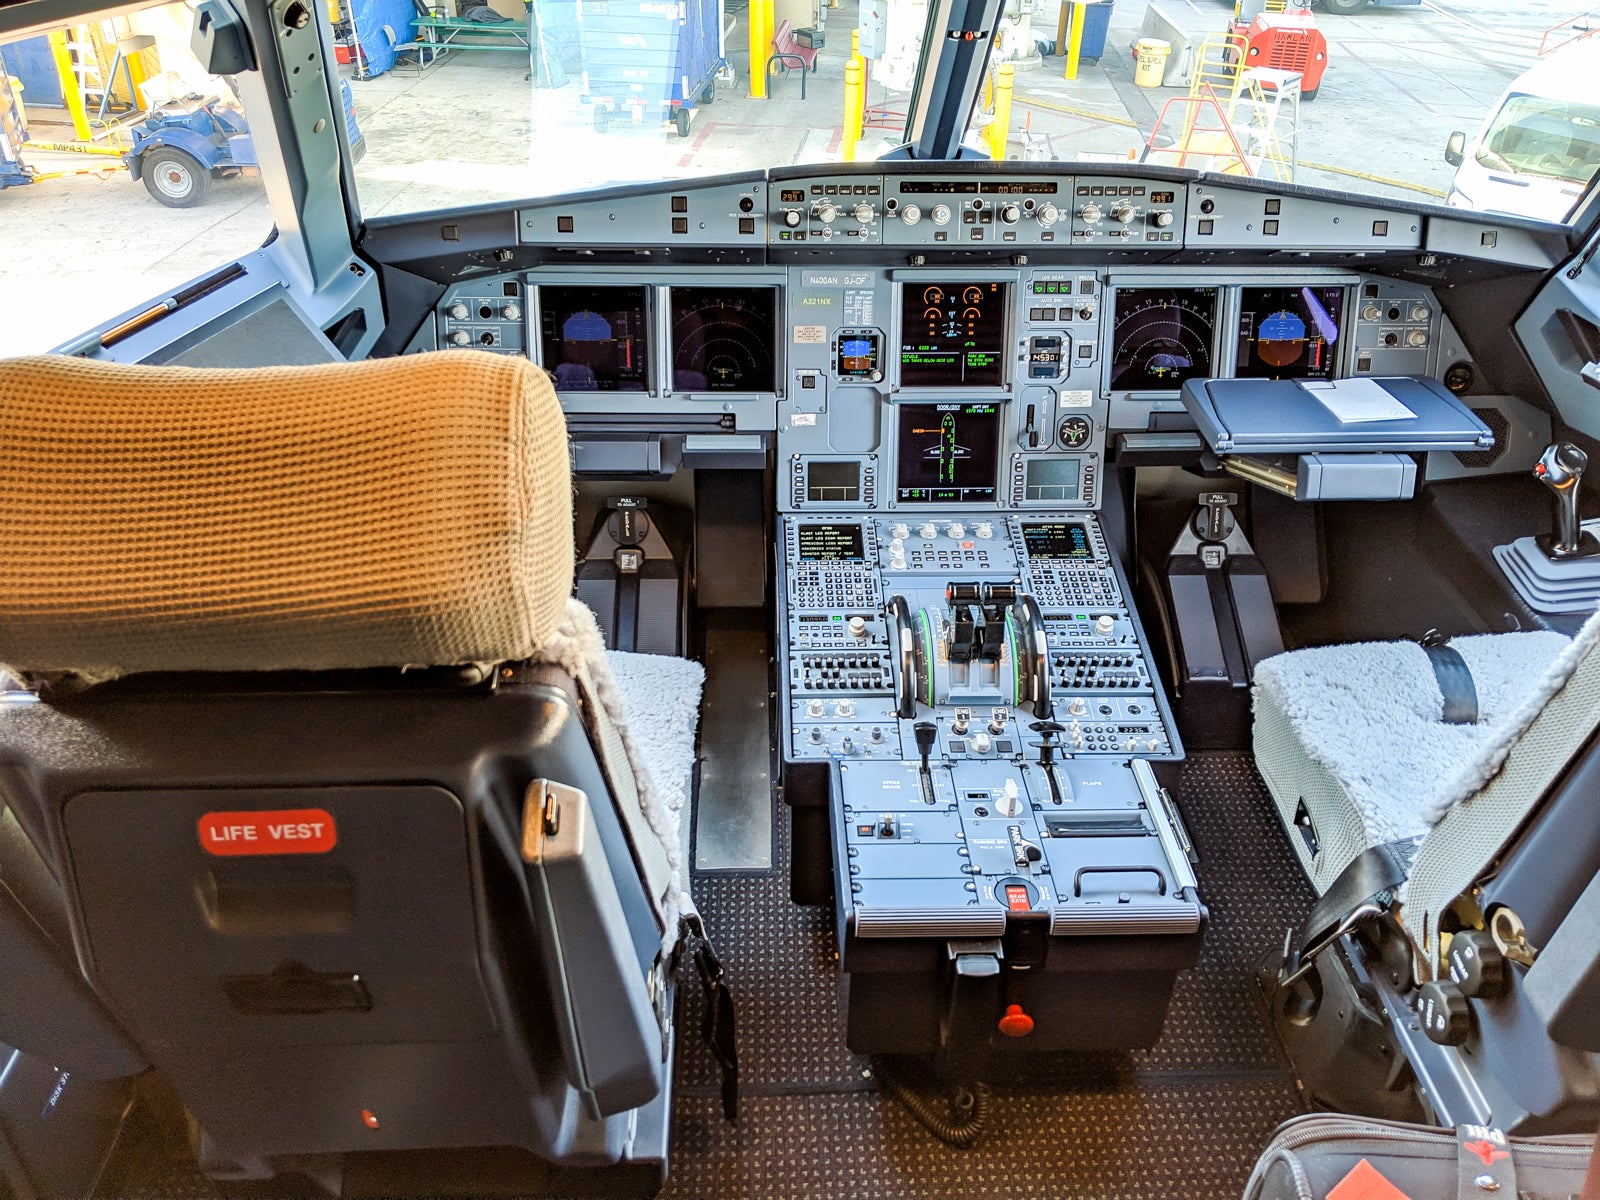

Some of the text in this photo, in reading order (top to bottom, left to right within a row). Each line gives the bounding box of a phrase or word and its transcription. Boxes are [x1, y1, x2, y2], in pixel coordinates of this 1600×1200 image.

[1274, 34, 1311, 42] HARLAN
[210, 823, 325, 842] LIFE VEST
[1010, 826, 1025, 862] PARK BRK
[50, 1084, 62, 1106] DISK
